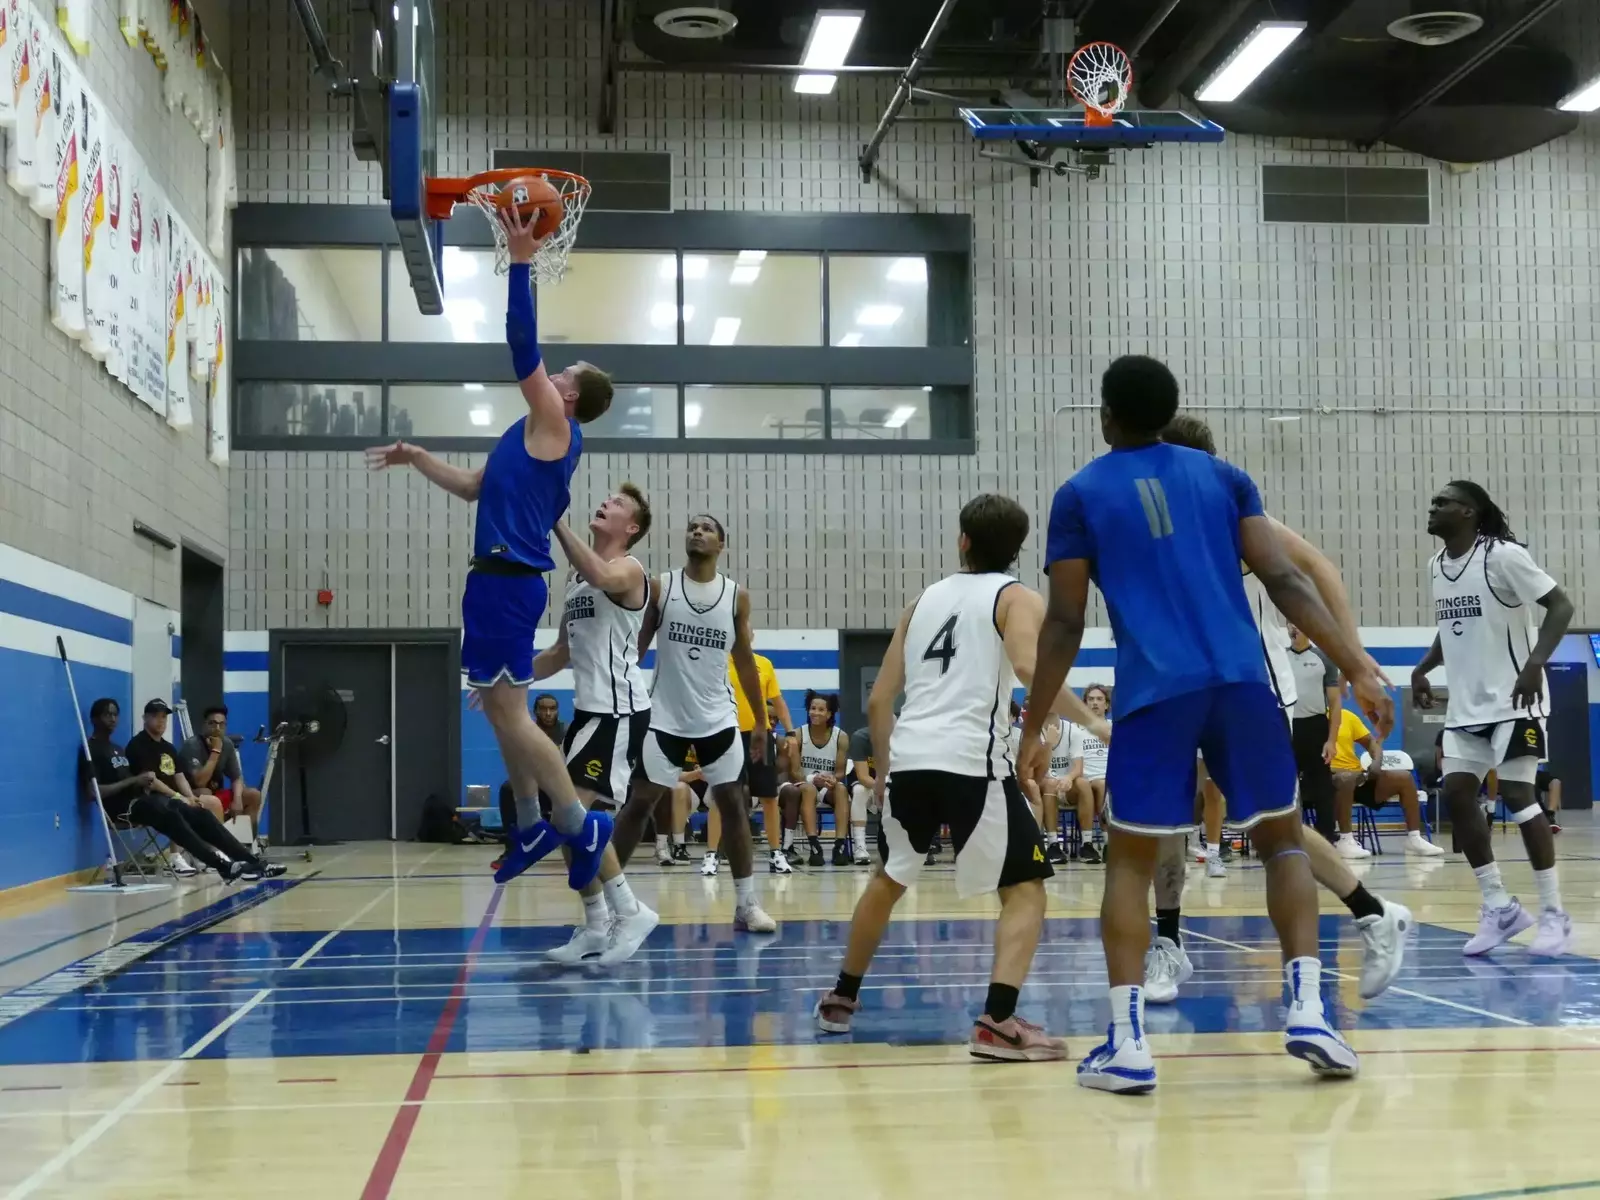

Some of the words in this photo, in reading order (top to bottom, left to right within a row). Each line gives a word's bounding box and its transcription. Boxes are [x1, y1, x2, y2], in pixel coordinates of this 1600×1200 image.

[669, 621, 727, 640] STINGERS
[922, 611, 961, 678] 4
[801, 756, 836, 766] STINGERS
[1033, 844, 1045, 863] 4
